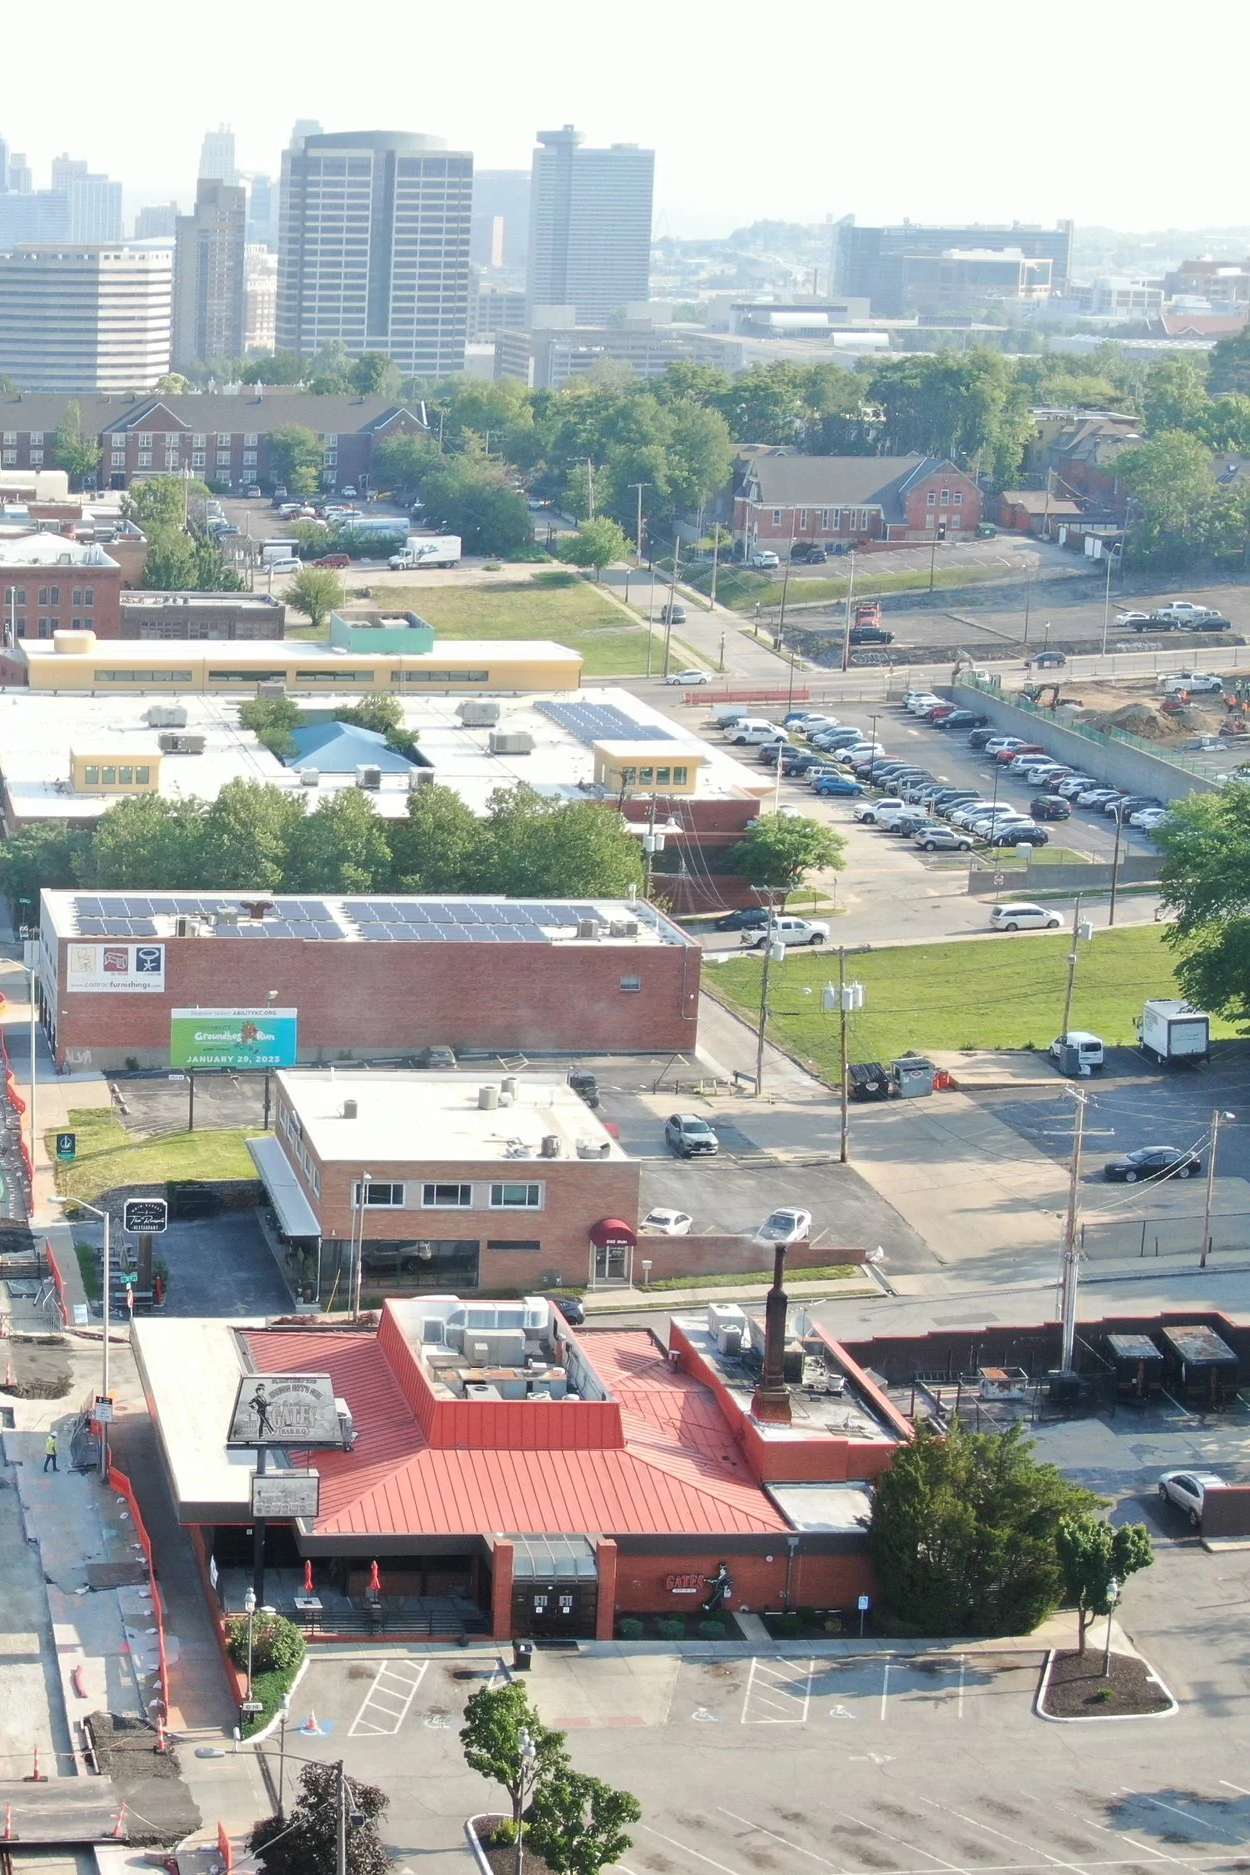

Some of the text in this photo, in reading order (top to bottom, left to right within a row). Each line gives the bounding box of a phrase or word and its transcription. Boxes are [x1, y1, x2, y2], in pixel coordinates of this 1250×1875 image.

[194, 1030, 275, 1042] Groundhog Run
[187, 1055, 280, 1064] JANUARY 29, 2023
[271, 1403, 318, 1428] GATES
[665, 1574, 705, 1590] GATES
